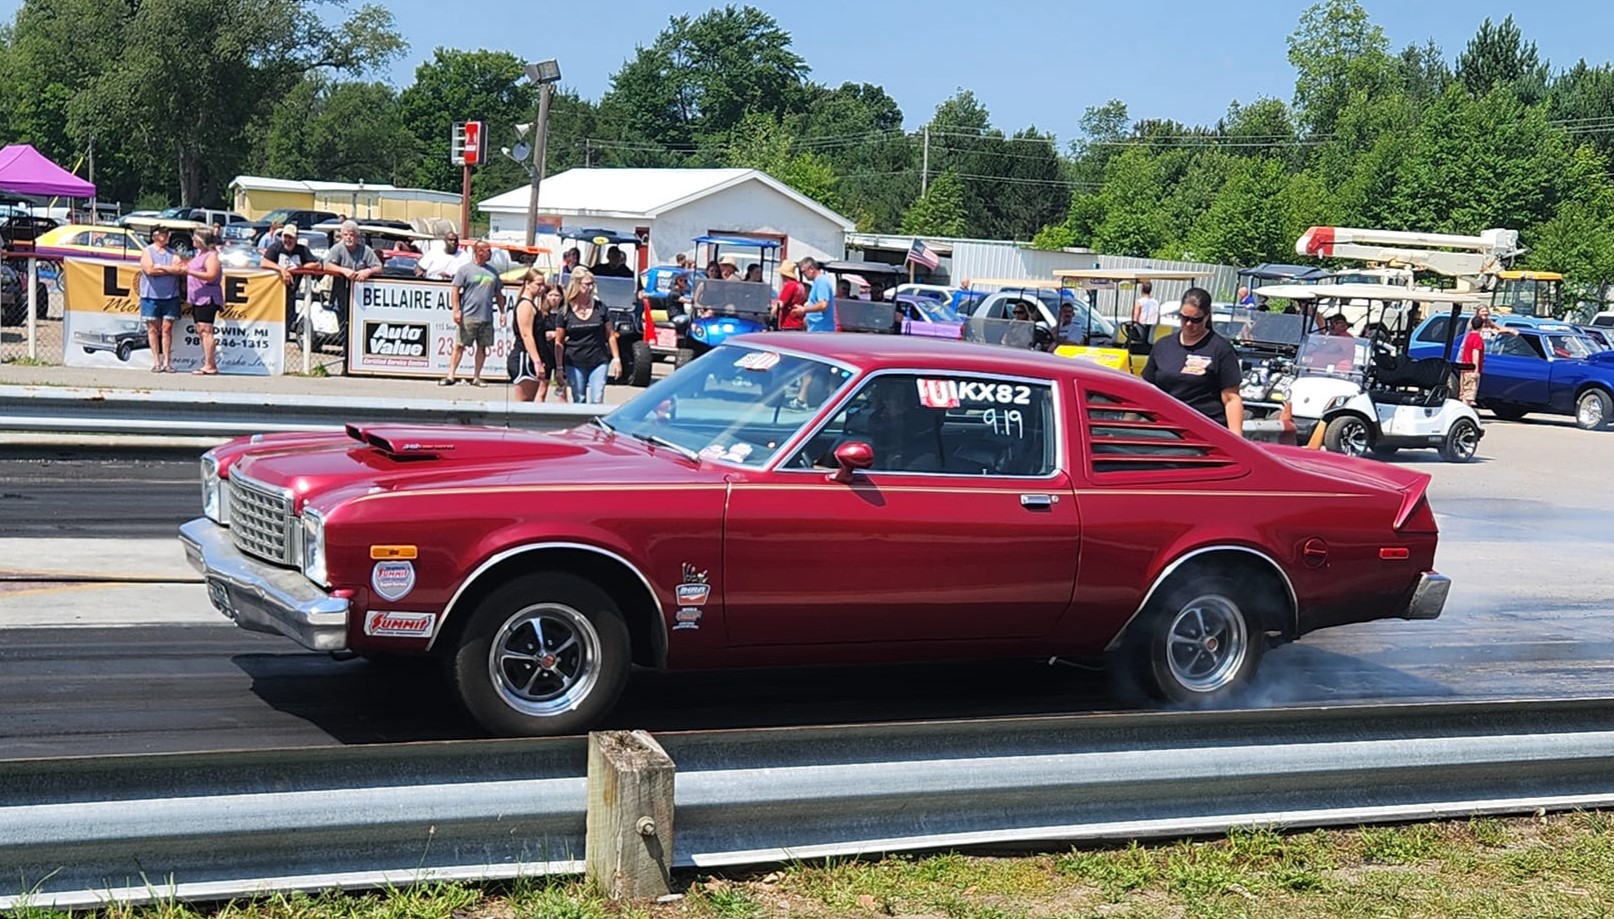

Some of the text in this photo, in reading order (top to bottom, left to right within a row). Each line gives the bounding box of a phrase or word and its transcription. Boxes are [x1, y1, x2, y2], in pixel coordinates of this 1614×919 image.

[362, 287, 432, 310] BELLAIRE
[254, 328, 269, 337] MI
[373, 323, 423, 341] Auto
[369, 339, 424, 357] Value
[958, 381, 1031, 405] KX82
[371, 613, 428, 630] SUMMIT
